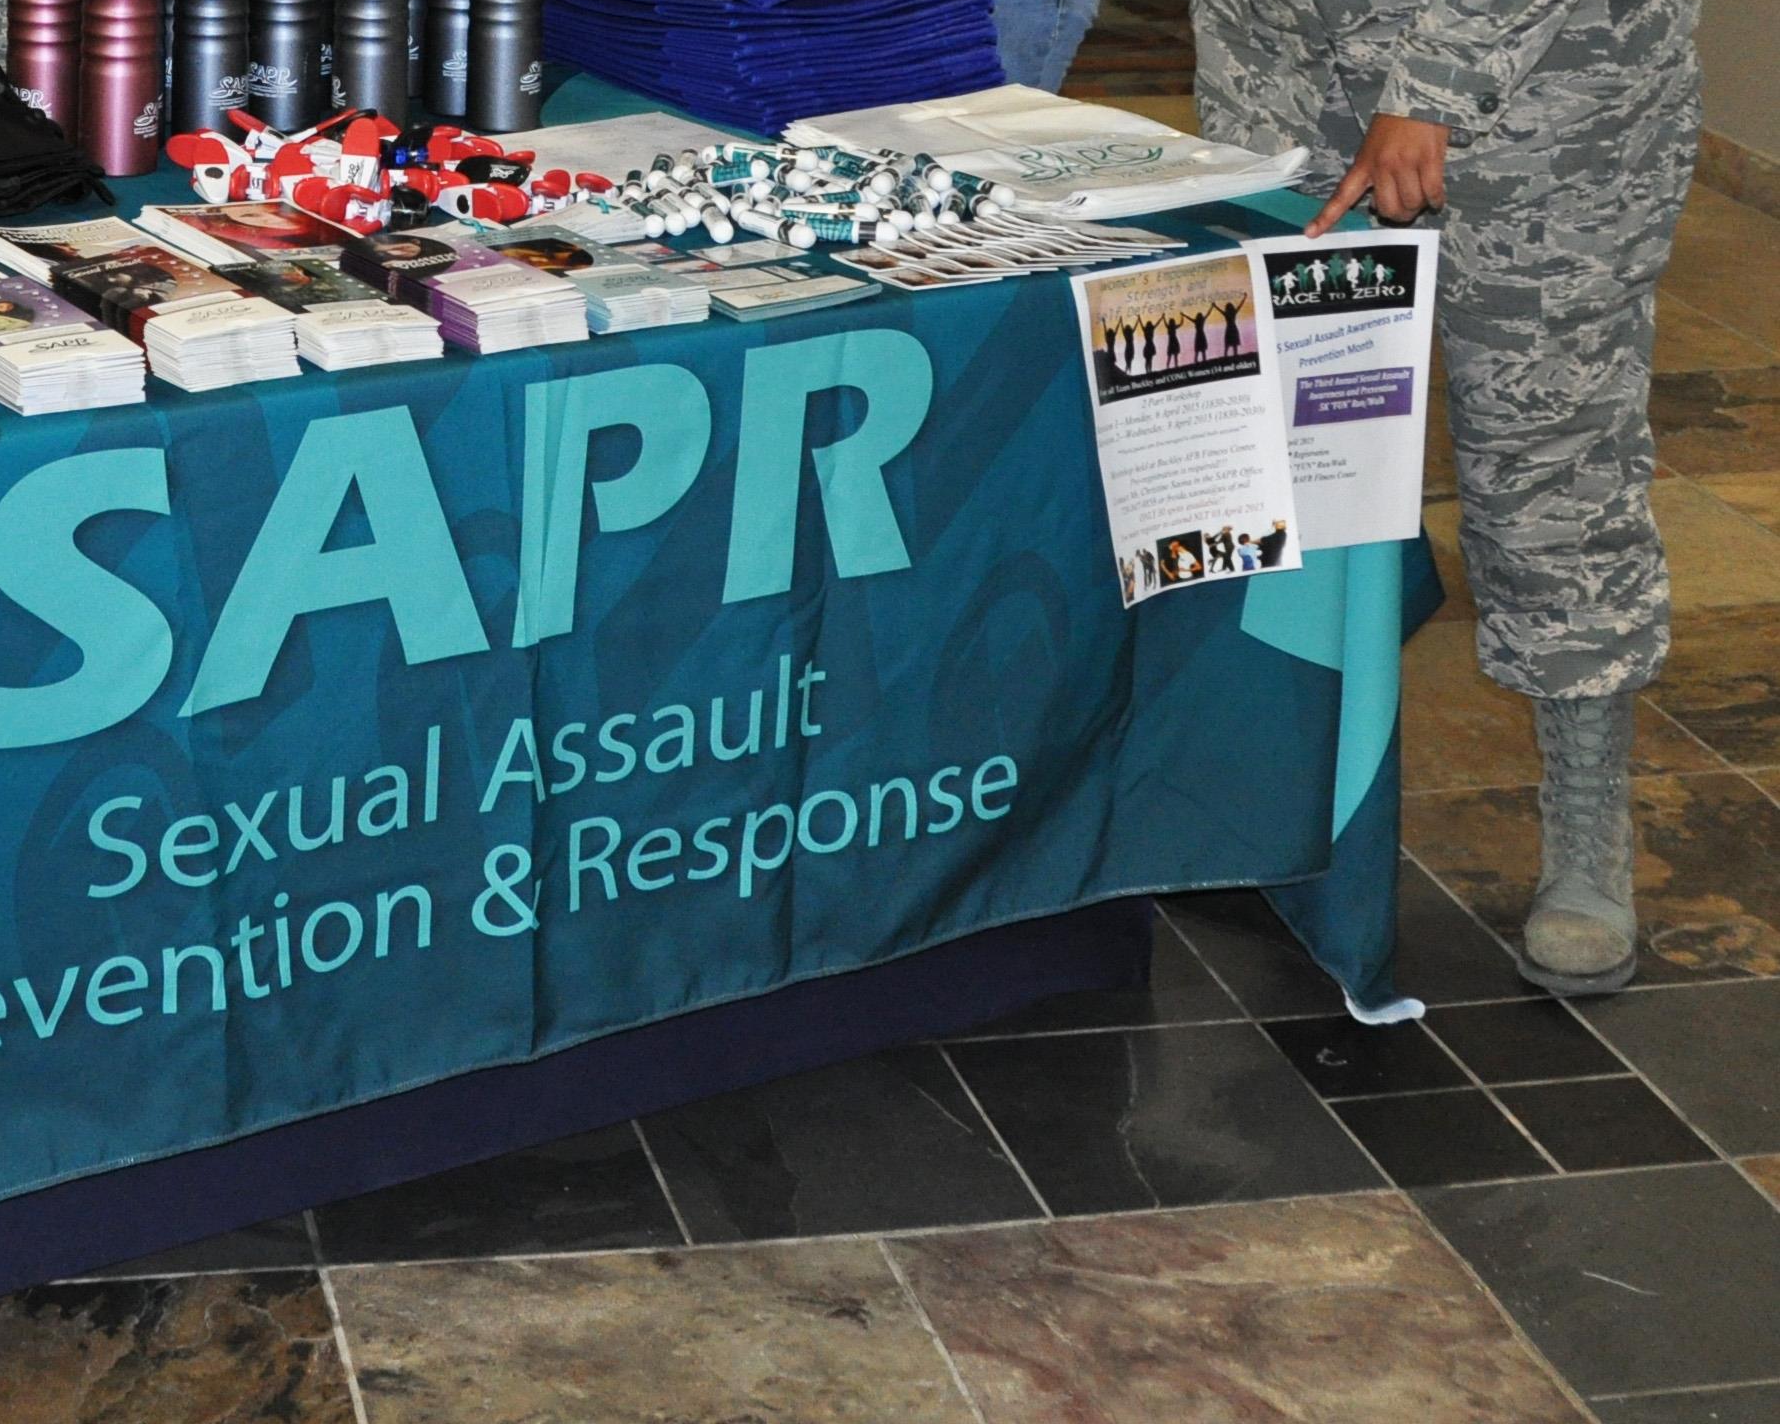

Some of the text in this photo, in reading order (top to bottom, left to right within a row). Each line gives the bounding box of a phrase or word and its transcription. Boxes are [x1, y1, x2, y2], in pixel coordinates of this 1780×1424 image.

[1272, 286, 1405, 306] RACE TO ZERO
[1285, 311, 1413, 352] Sexual Assault Awareness and
[1299, 340, 1374, 368] Prevention Month
[87, 656, 826, 900] Sexual Assault
[471, 843, 540, 938] &
[570, 753, 1019, 916] Response
